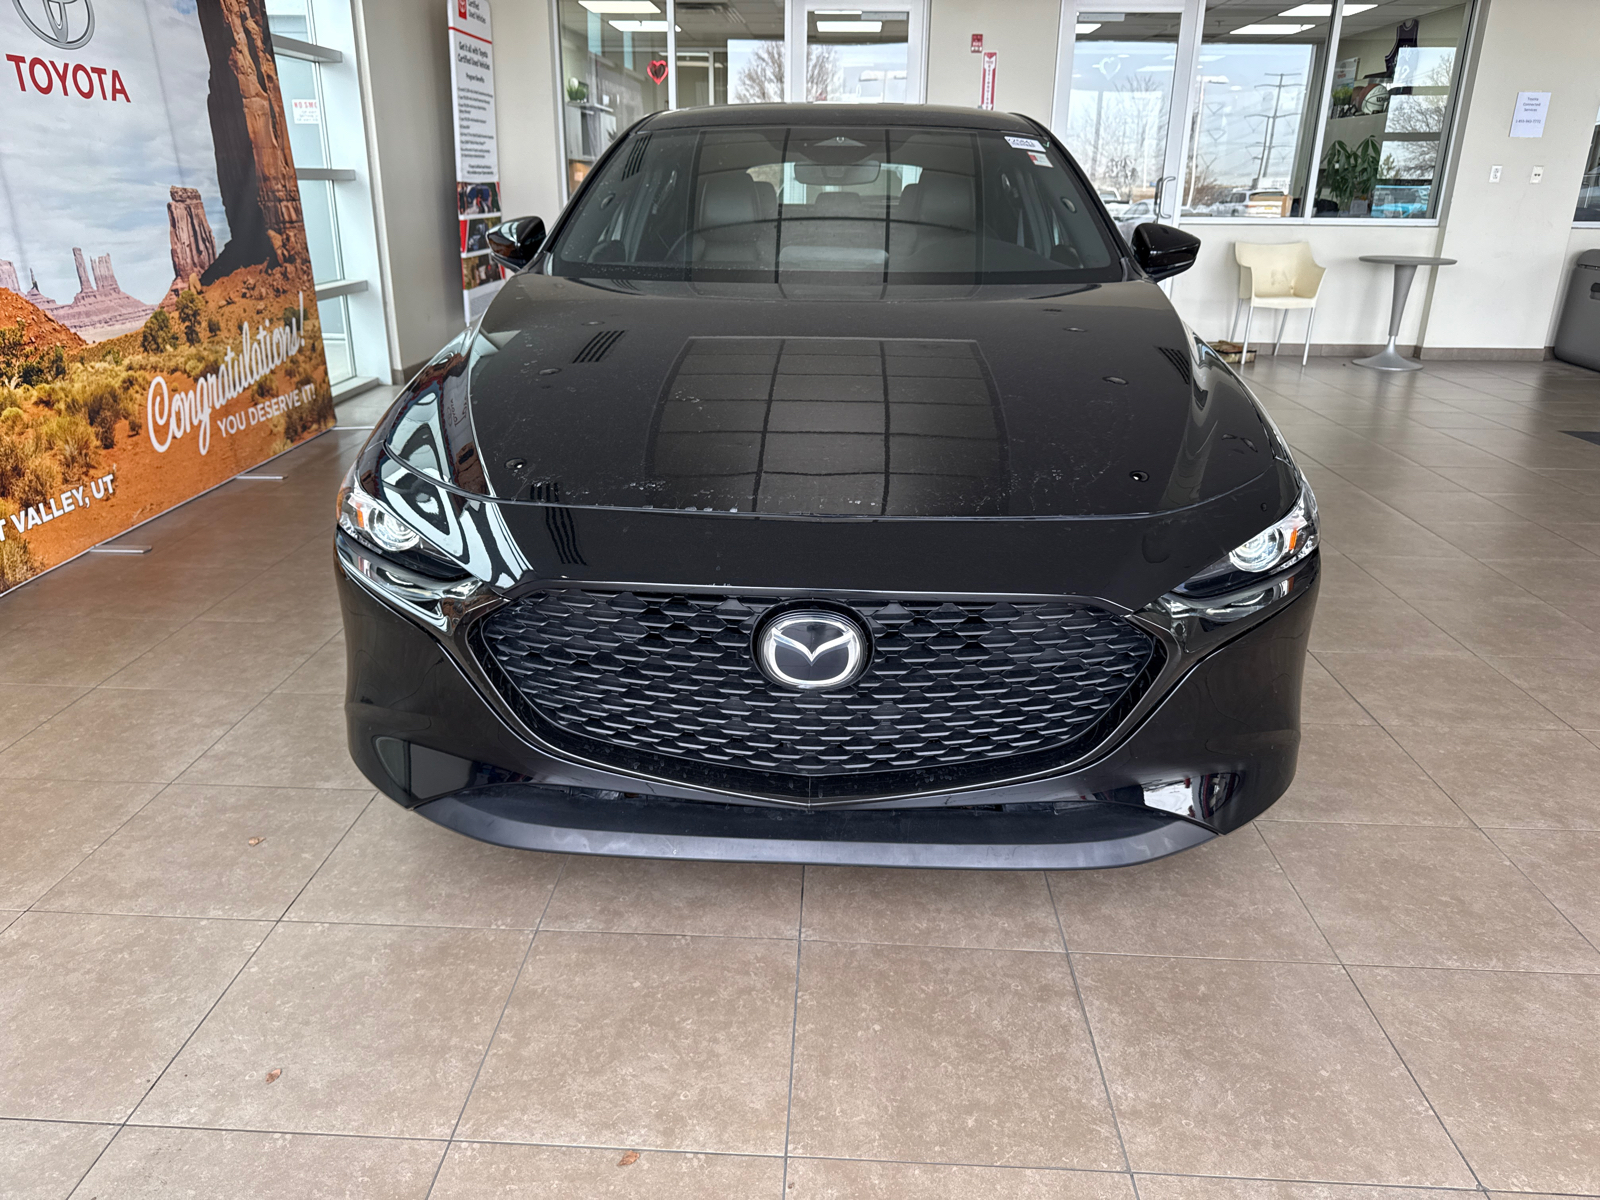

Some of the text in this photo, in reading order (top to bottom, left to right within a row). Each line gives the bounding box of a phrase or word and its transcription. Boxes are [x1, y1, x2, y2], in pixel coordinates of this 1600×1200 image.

[5, 53, 131, 103] TOYOTA
[457, 53, 471, 65] Certified
[479, 59, 491, 71] Vehicles
[479, 47, 489, 59] Toyota
[147, 290, 306, 456] Congratulations!
[217, 383, 316, 438] YOU DESERVE IT!
[10, 485, 90, 533] VALLEY,
[90, 473, 114, 499] UT
